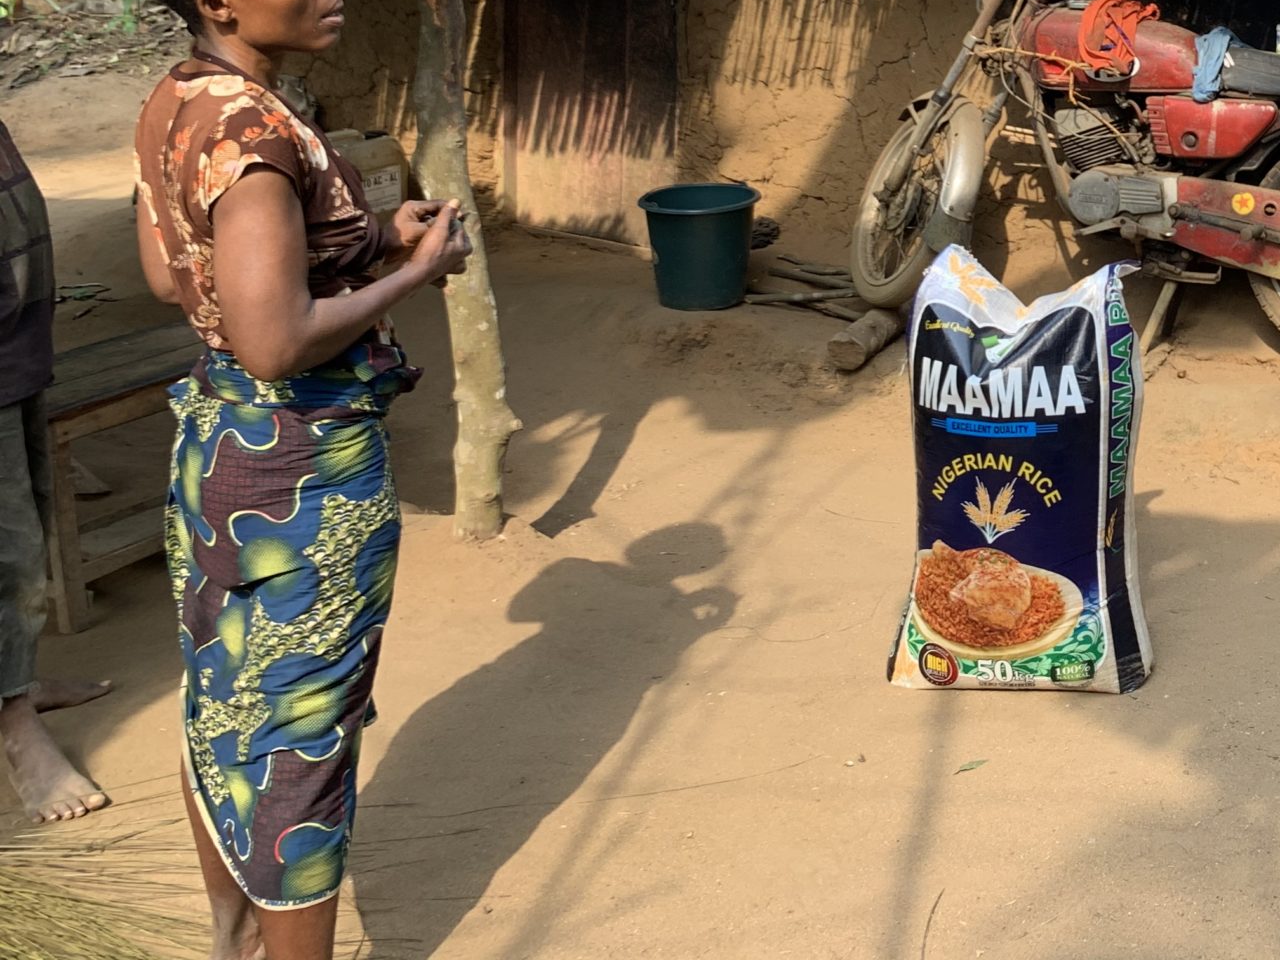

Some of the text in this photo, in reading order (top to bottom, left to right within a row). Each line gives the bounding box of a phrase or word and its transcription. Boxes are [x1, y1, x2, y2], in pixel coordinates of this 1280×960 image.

[919, 356, 1086, 418] MAAMAA
[1109, 331, 1133, 499] MAAMAA
[951, 421, 1029, 435] EXCELLENT QUALITY
[931, 452, 1062, 508] NIGERIAN RICE
[1055, 662, 1091, 676] 100%
